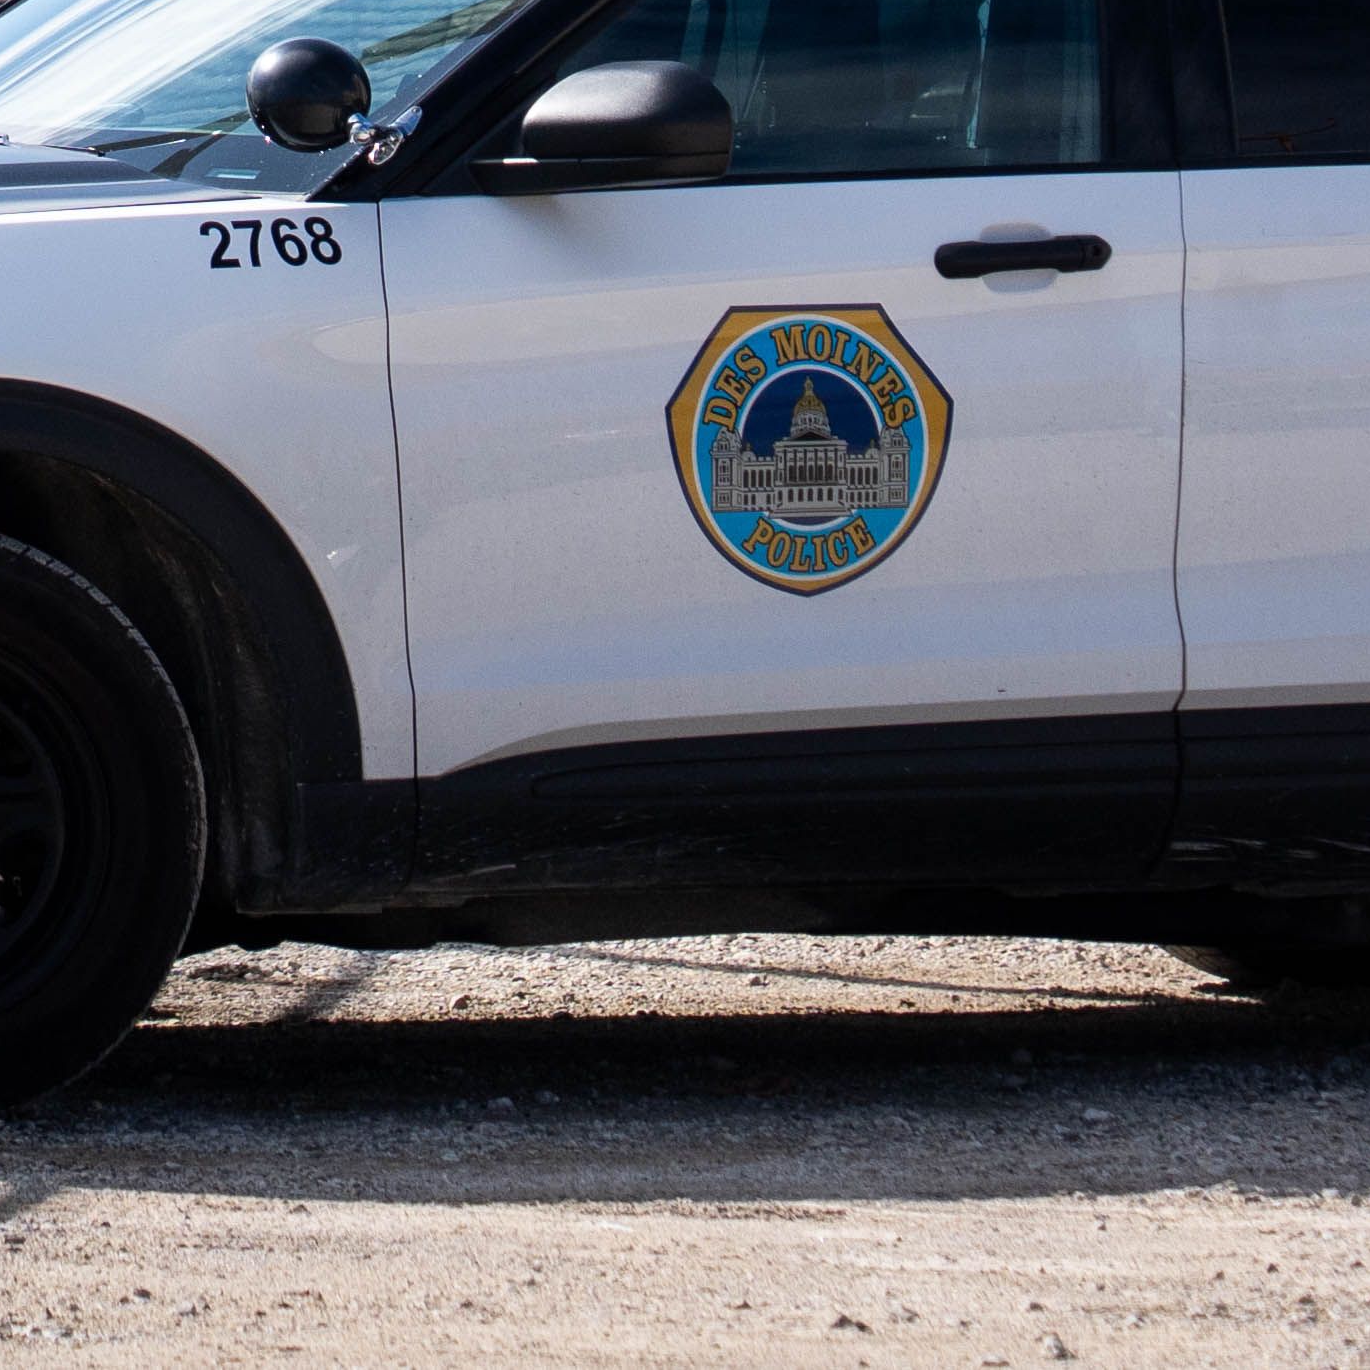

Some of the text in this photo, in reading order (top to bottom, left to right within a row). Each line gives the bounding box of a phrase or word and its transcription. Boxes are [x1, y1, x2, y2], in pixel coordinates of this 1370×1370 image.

[199, 216, 343, 269] 2768
[704, 324, 918, 431] DES MOINES
[742, 516, 876, 573] POLICE
